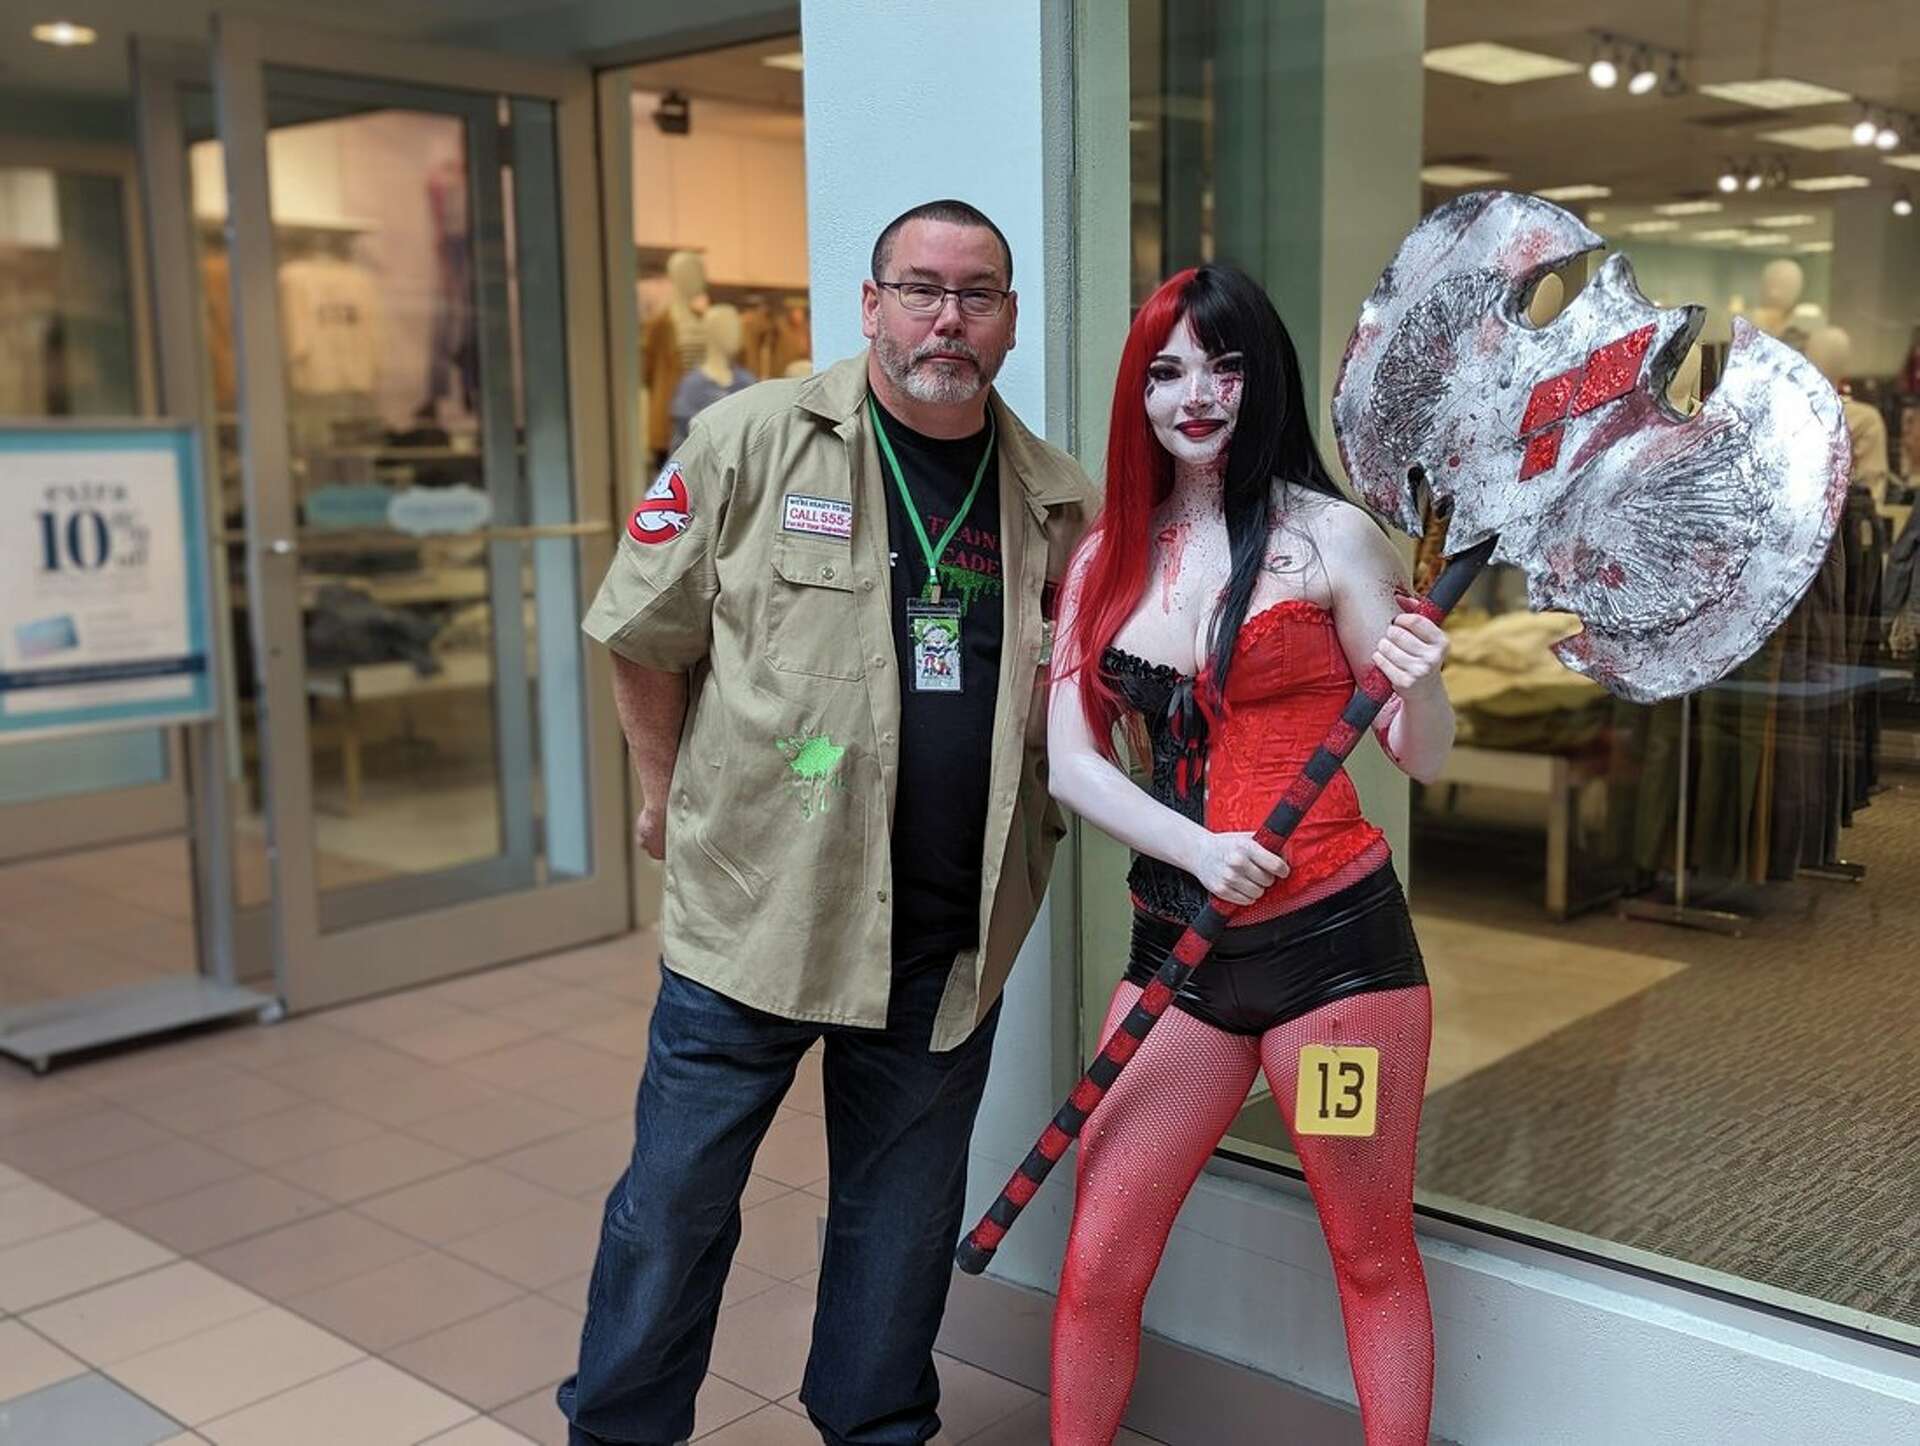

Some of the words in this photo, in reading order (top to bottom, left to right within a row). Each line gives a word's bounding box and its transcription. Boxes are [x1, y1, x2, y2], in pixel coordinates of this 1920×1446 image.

[36, 508, 109, 571] 10
[790, 507, 819, 521] CALL
[1317, 1062, 1365, 1119] 13
